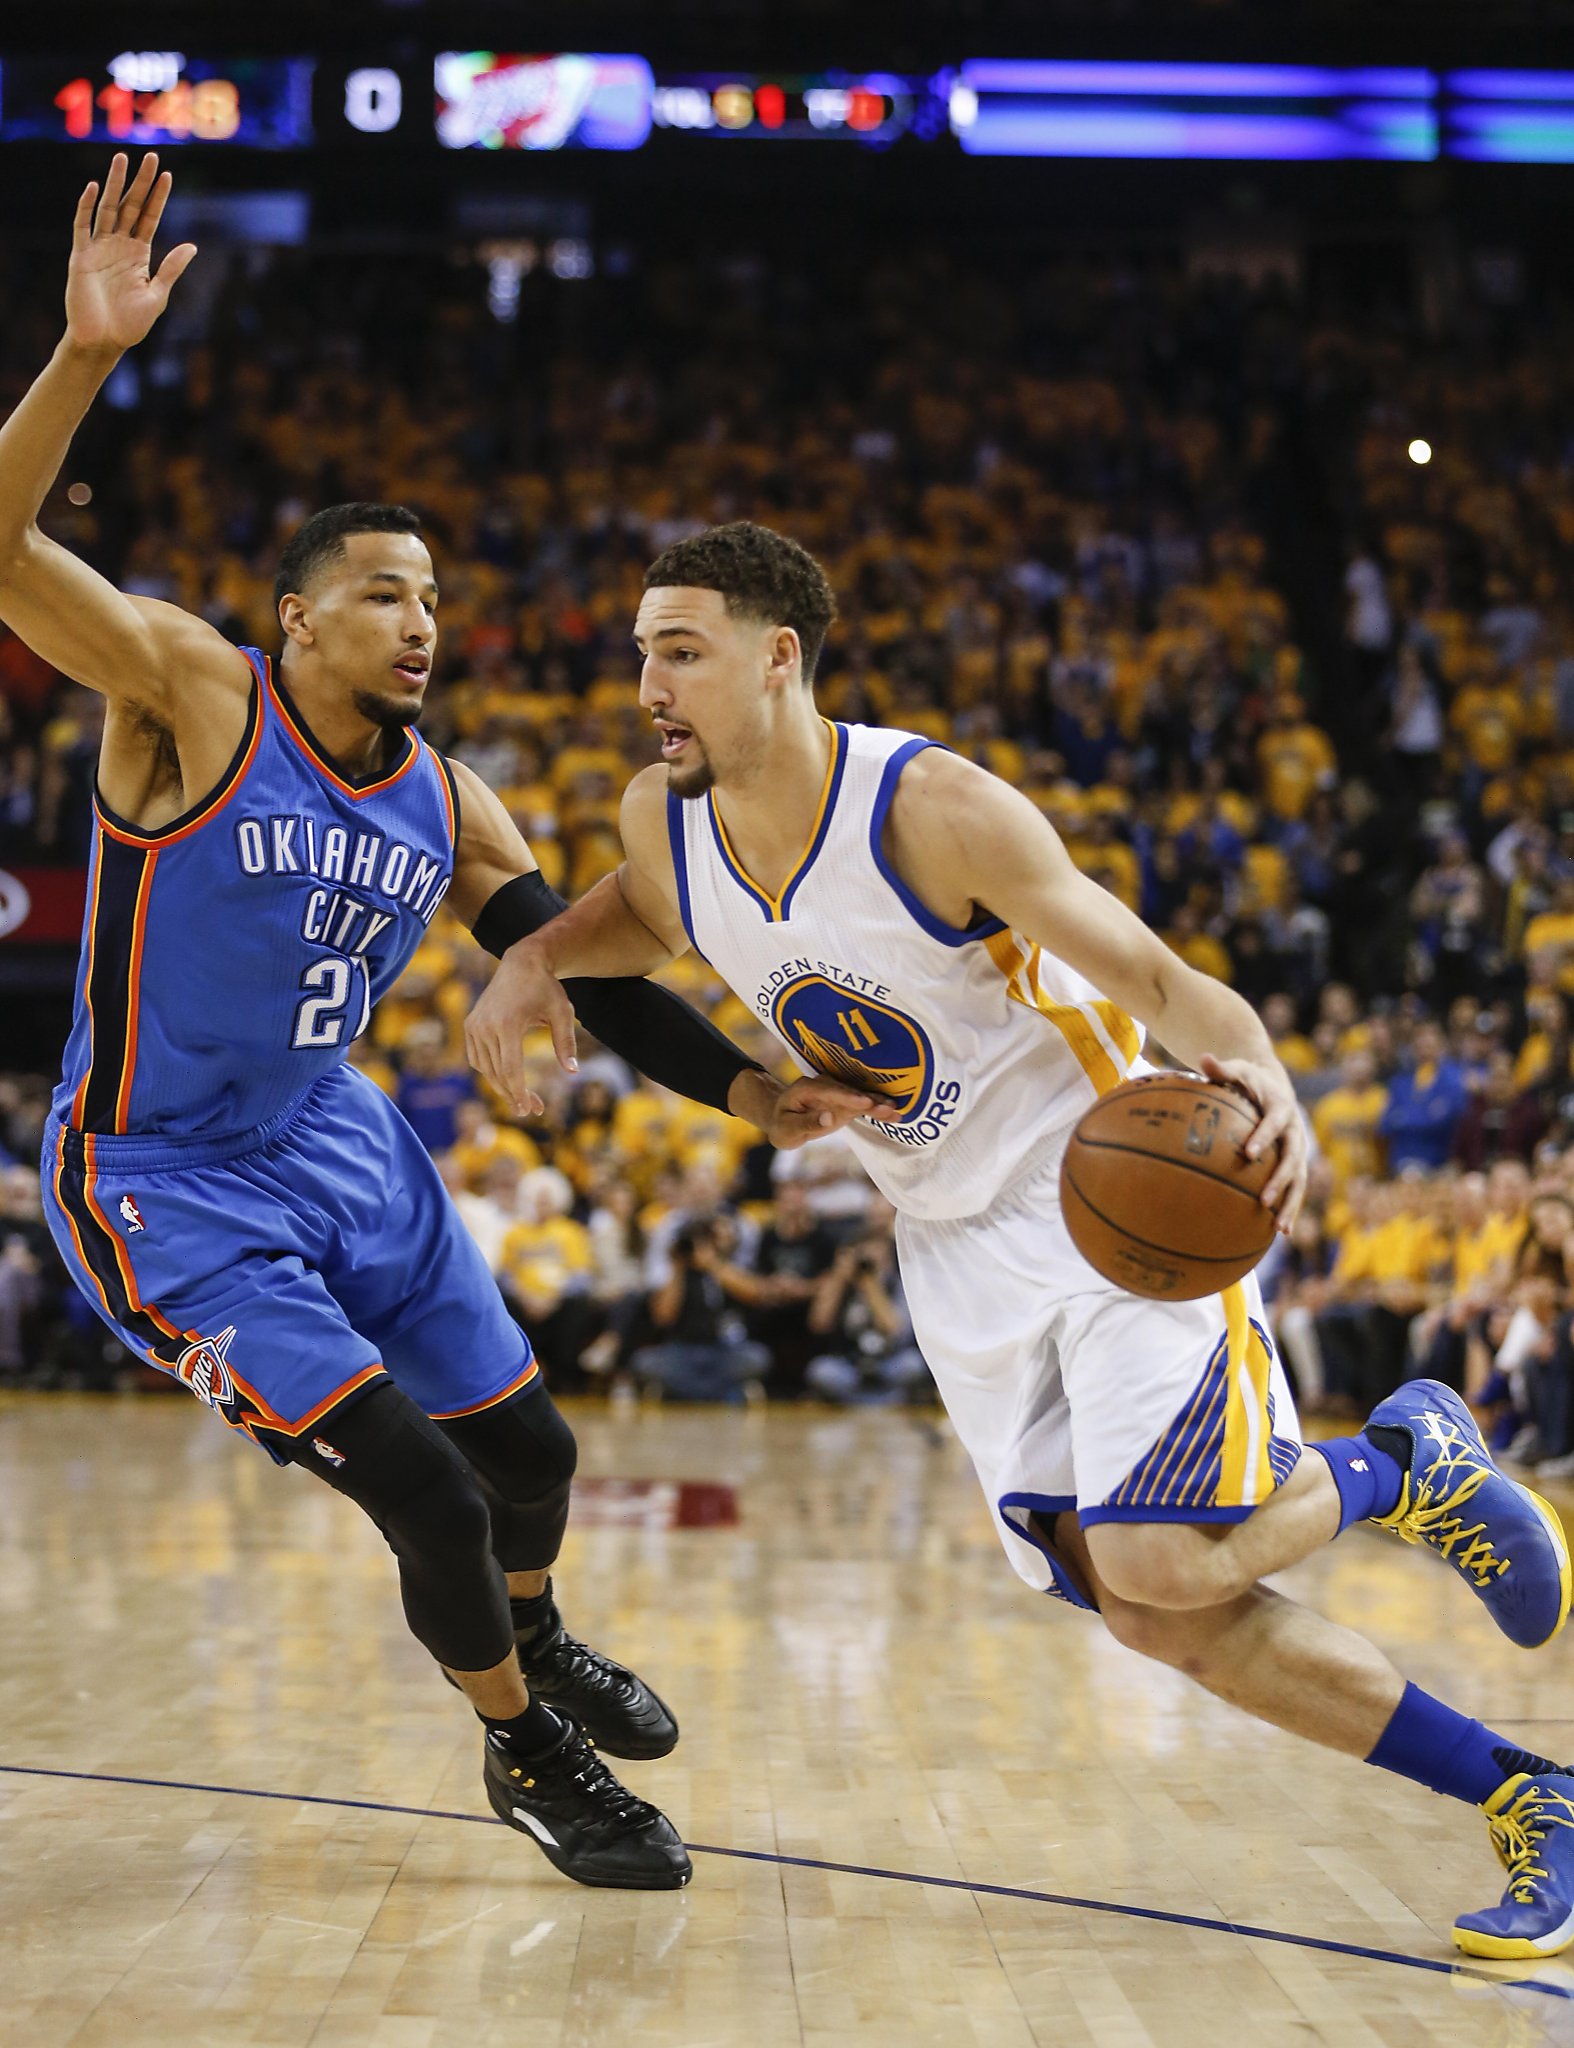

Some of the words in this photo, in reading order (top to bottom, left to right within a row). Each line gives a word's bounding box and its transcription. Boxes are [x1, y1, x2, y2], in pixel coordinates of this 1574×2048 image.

[302, 887, 397, 954] CITY
[756, 957, 813, 1018] GOLDEN
[816, 960, 891, 1001] STATE
[836, 1007, 881, 1051] 11
[862, 1080, 961, 1146] ARRIORS
